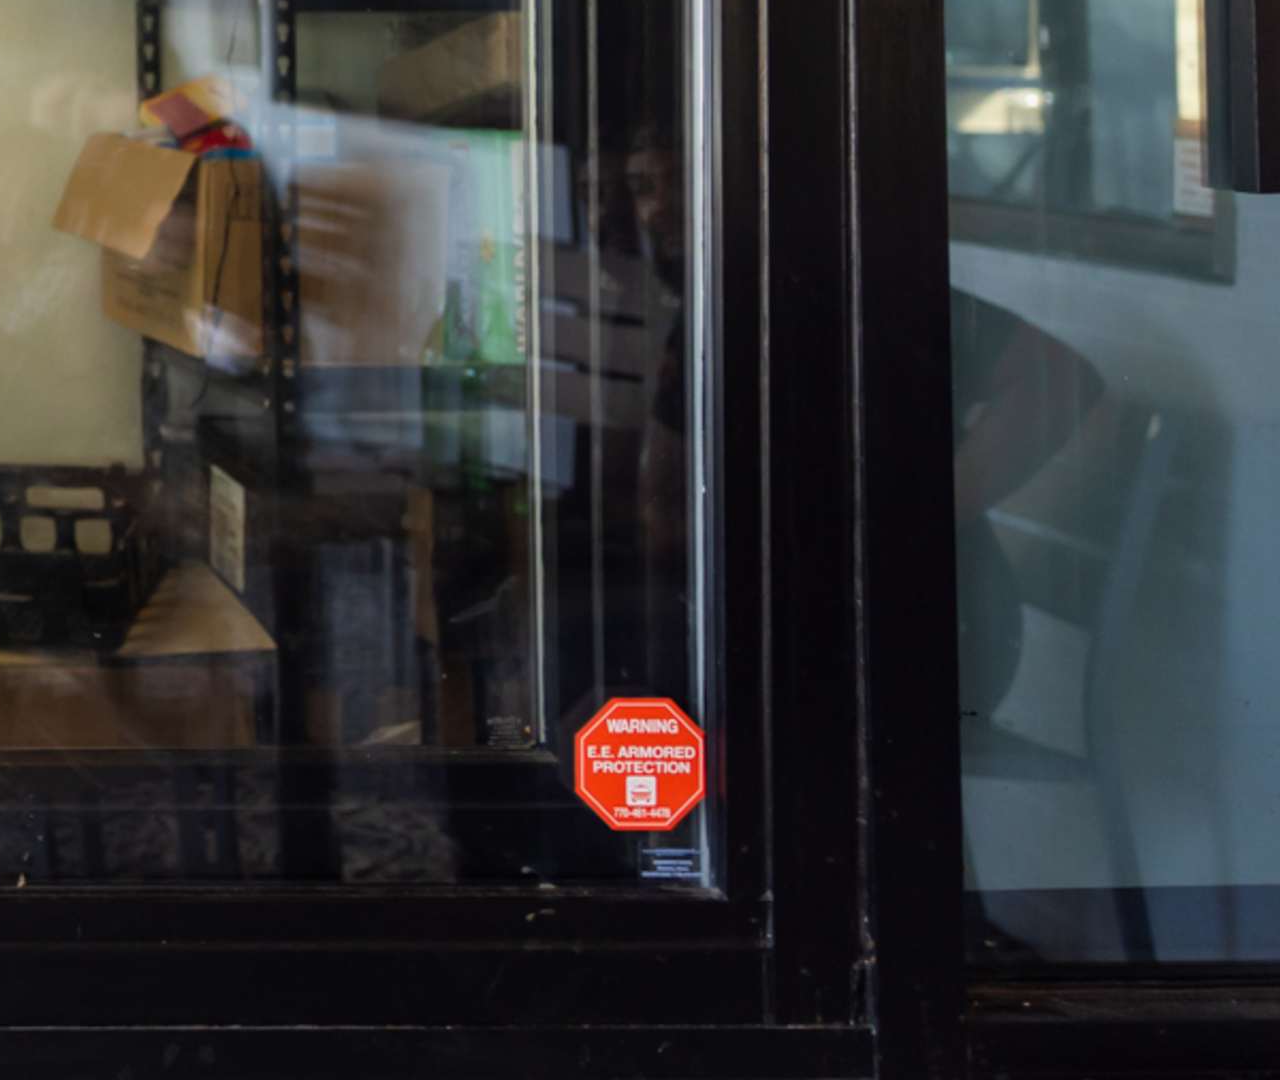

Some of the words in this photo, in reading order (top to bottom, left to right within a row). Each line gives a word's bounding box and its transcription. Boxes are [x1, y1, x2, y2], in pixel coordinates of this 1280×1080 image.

[606, 718, 679, 734] WARNING
[587, 745, 614, 758] E.E.
[618, 745, 696, 759] ARMORED
[593, 761, 691, 775] PROTECTION
